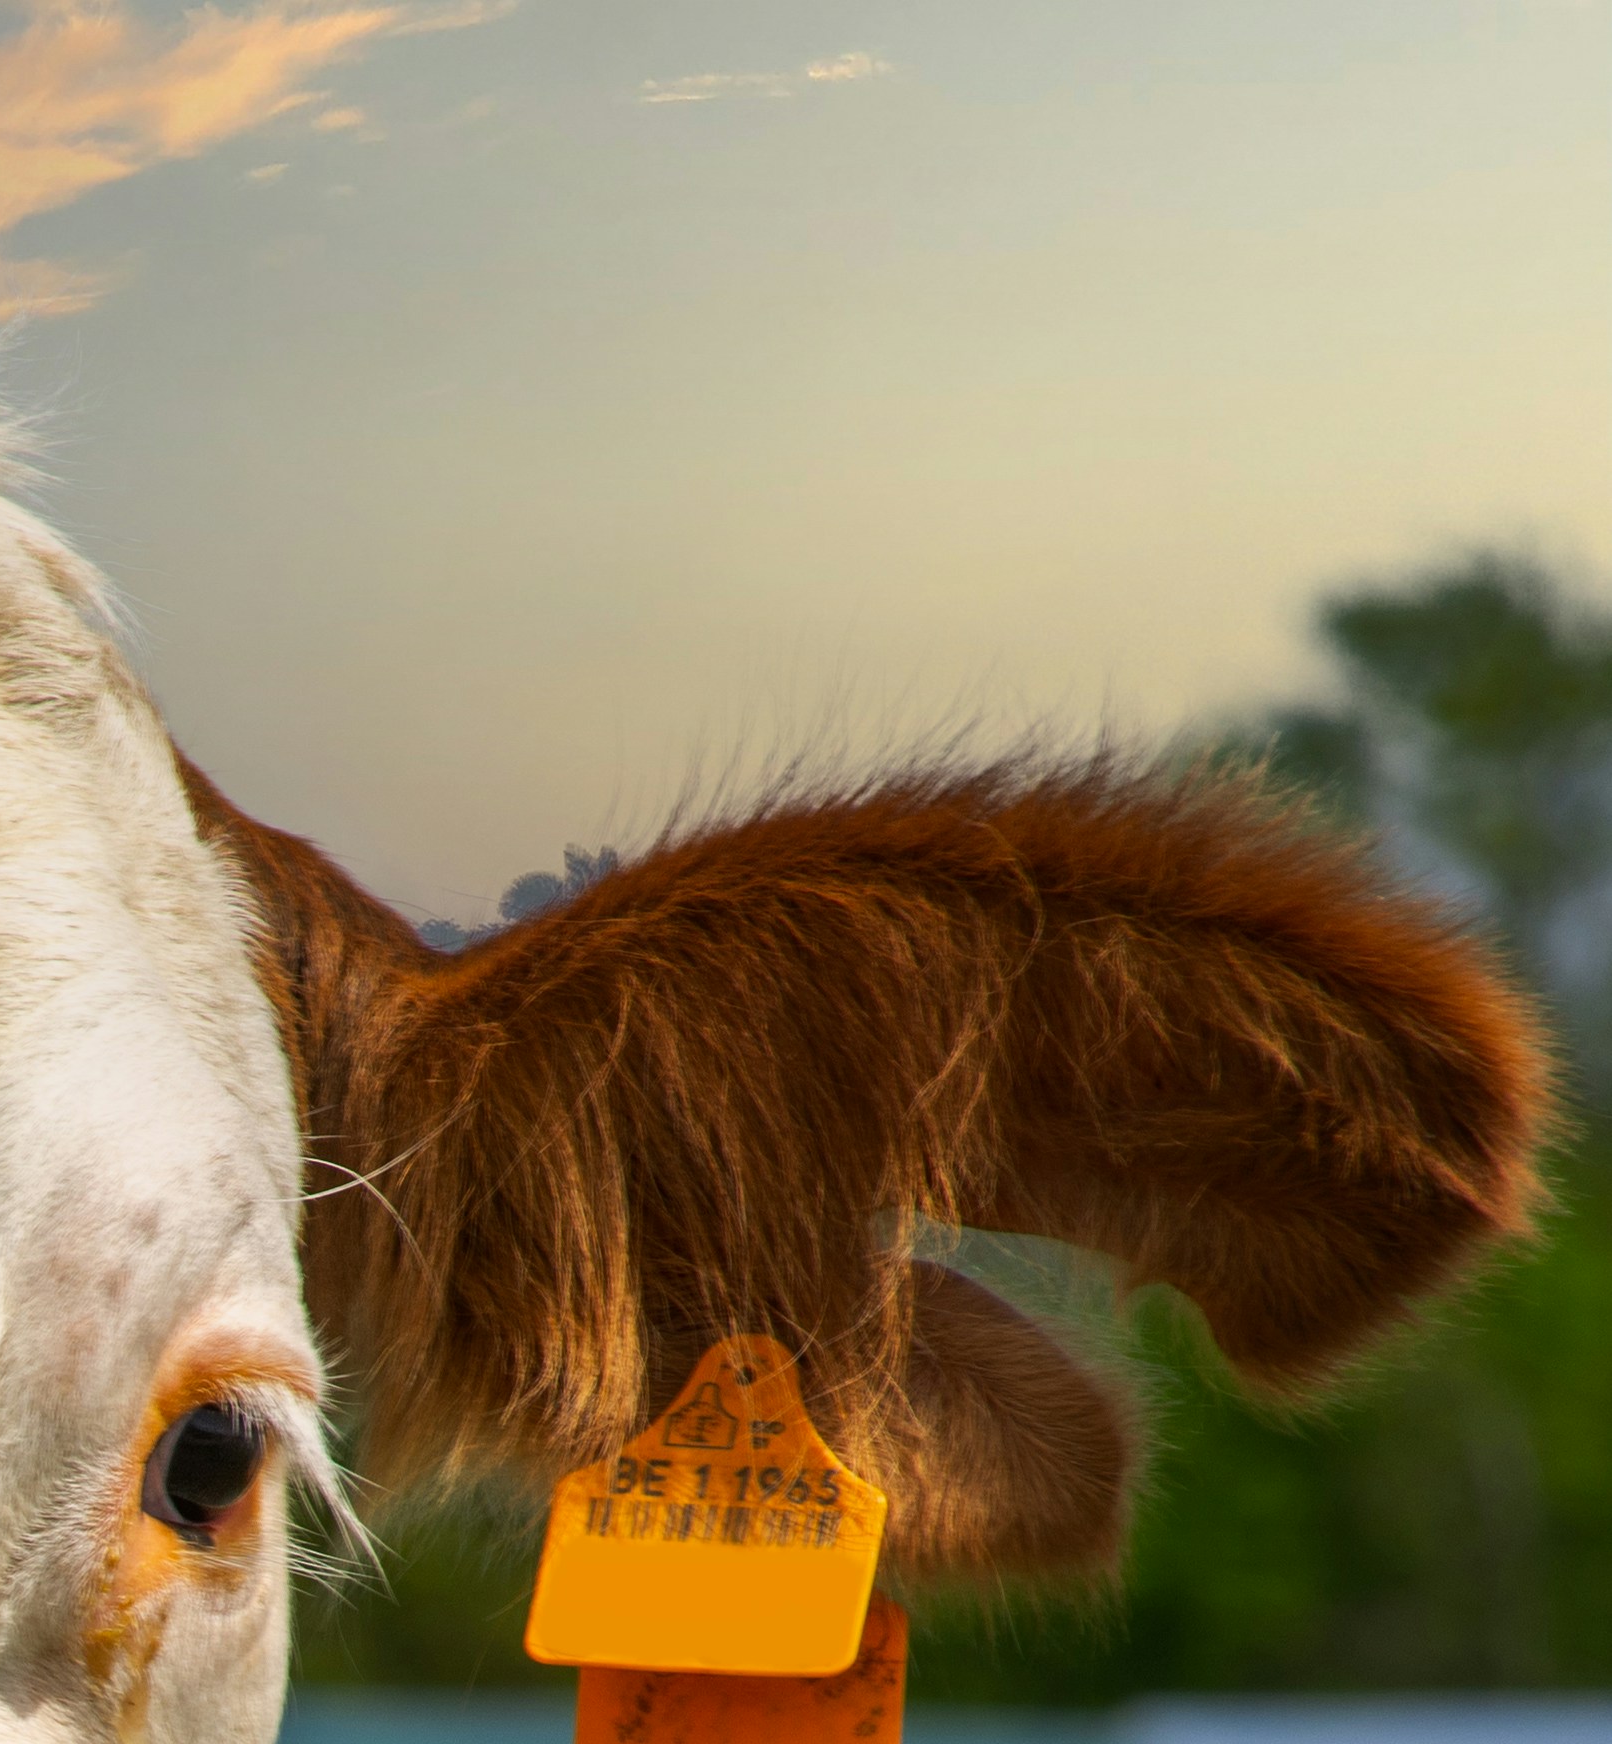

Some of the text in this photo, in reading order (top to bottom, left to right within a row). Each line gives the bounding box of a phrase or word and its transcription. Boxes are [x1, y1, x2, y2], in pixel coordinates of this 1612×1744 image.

[611, 1456, 841, 1506] BE 1 1965
